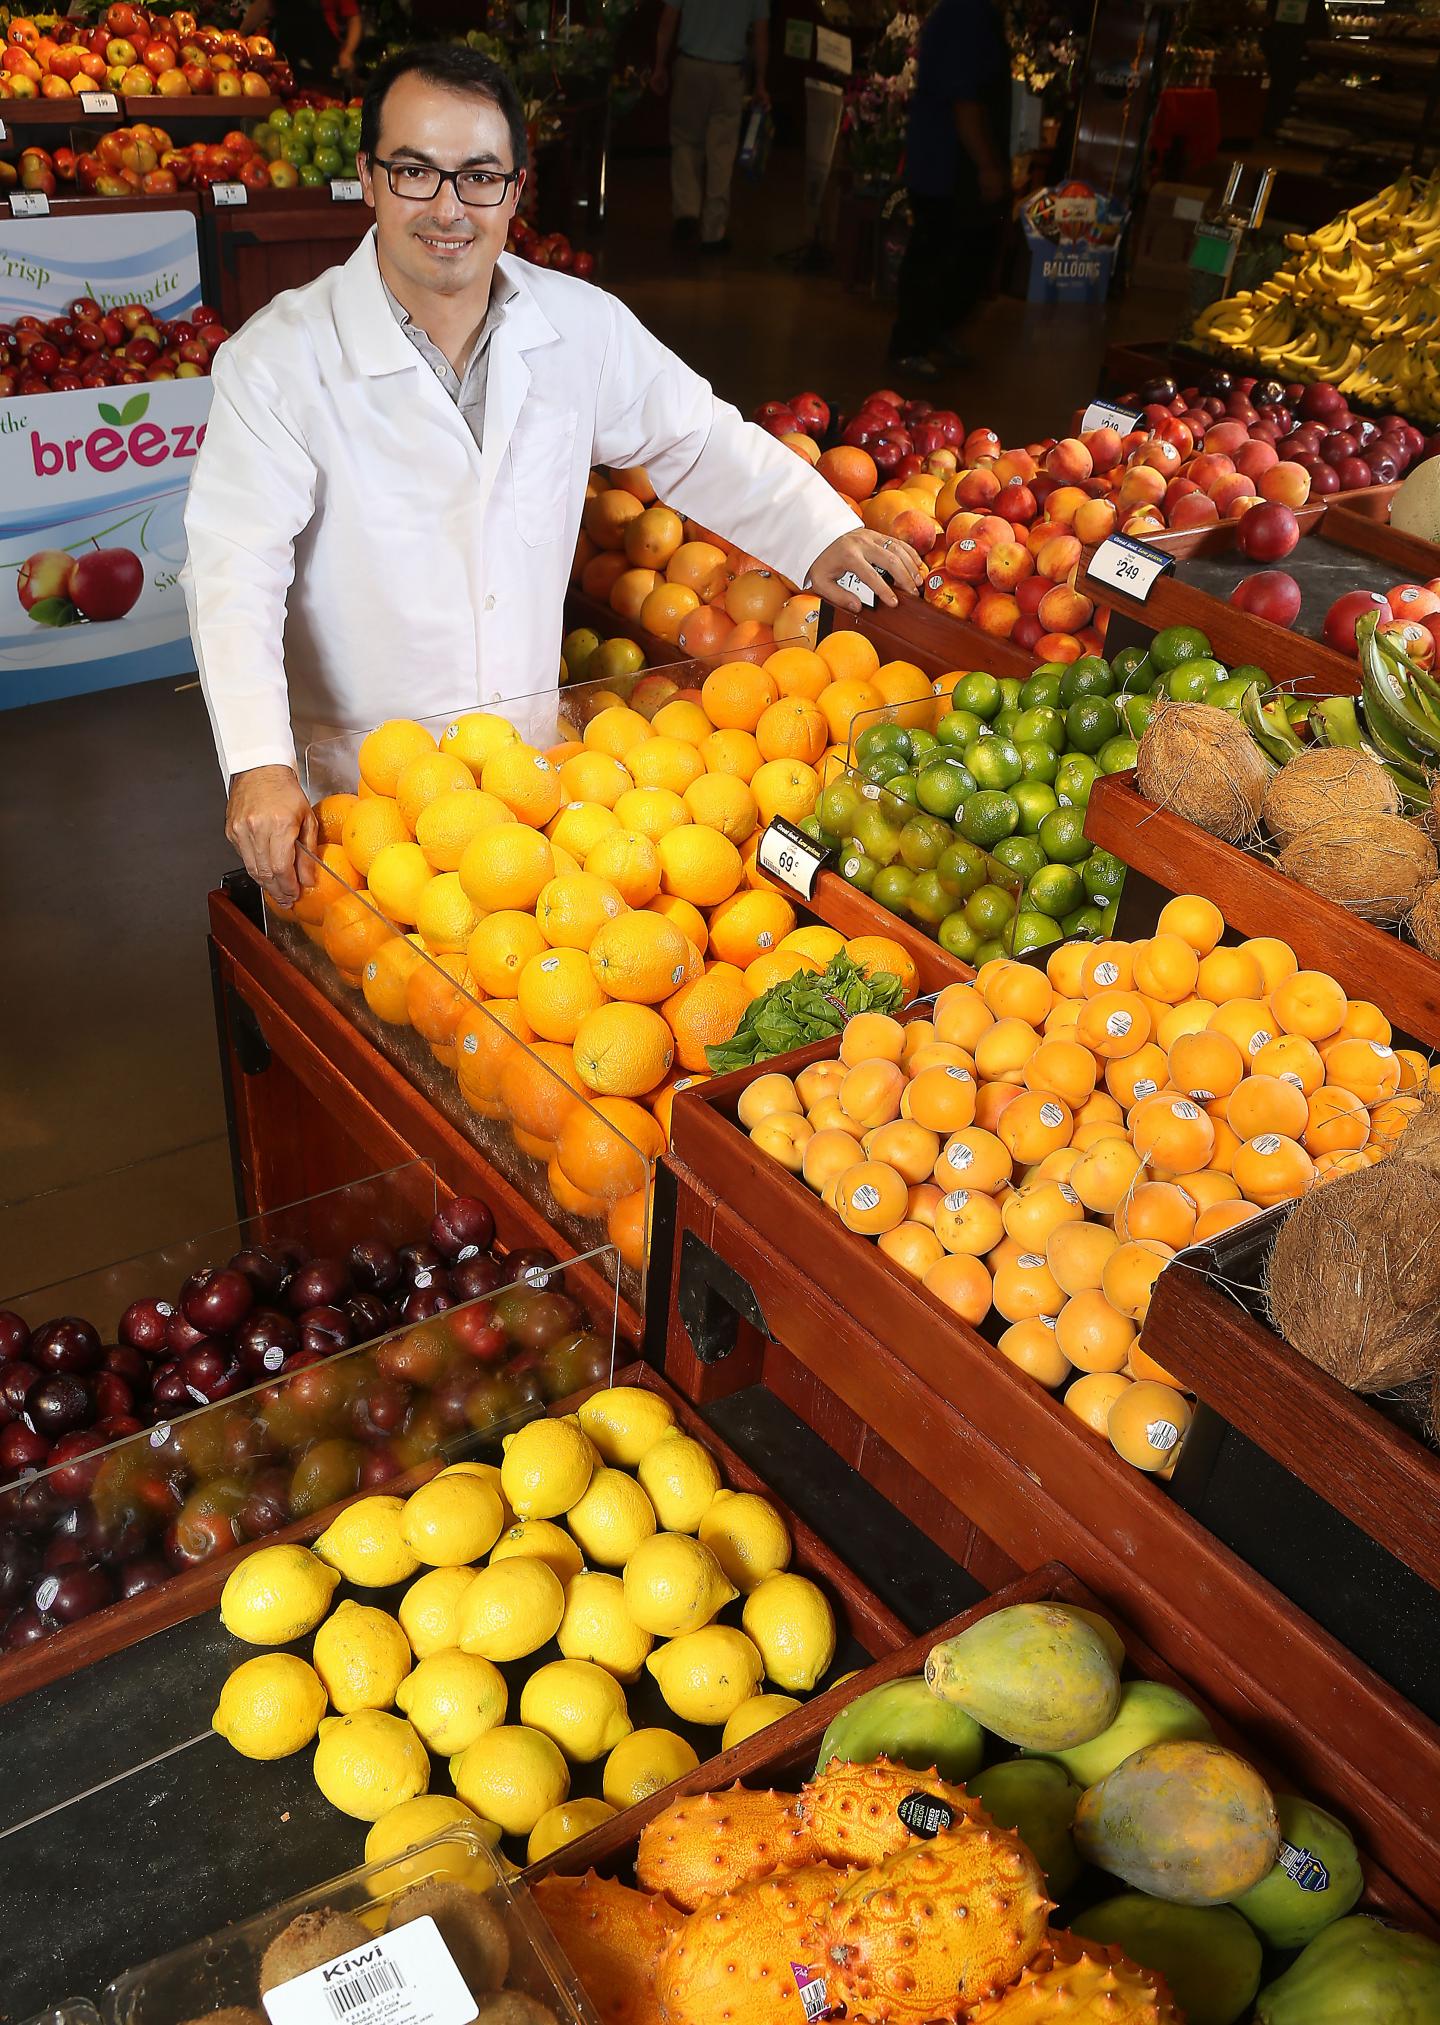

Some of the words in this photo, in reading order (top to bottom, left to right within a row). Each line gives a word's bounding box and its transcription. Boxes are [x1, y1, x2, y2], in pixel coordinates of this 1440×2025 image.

[1043, 261, 1101, 278] BALLOONS
[83, 272, 179, 308] Aromatic
[0, 411, 29, 434] the
[1113, 536, 1128, 547] Great
[1126, 542, 1139, 552] food.
[1137, 545, 1148, 555] Low
[1116, 560, 1140, 580] $249
[776, 823, 790, 836] Great
[797, 838, 809, 848] Low
[916, 1804, 925, 1828] MELON
[322, 1945, 383, 1982] Kiwi
